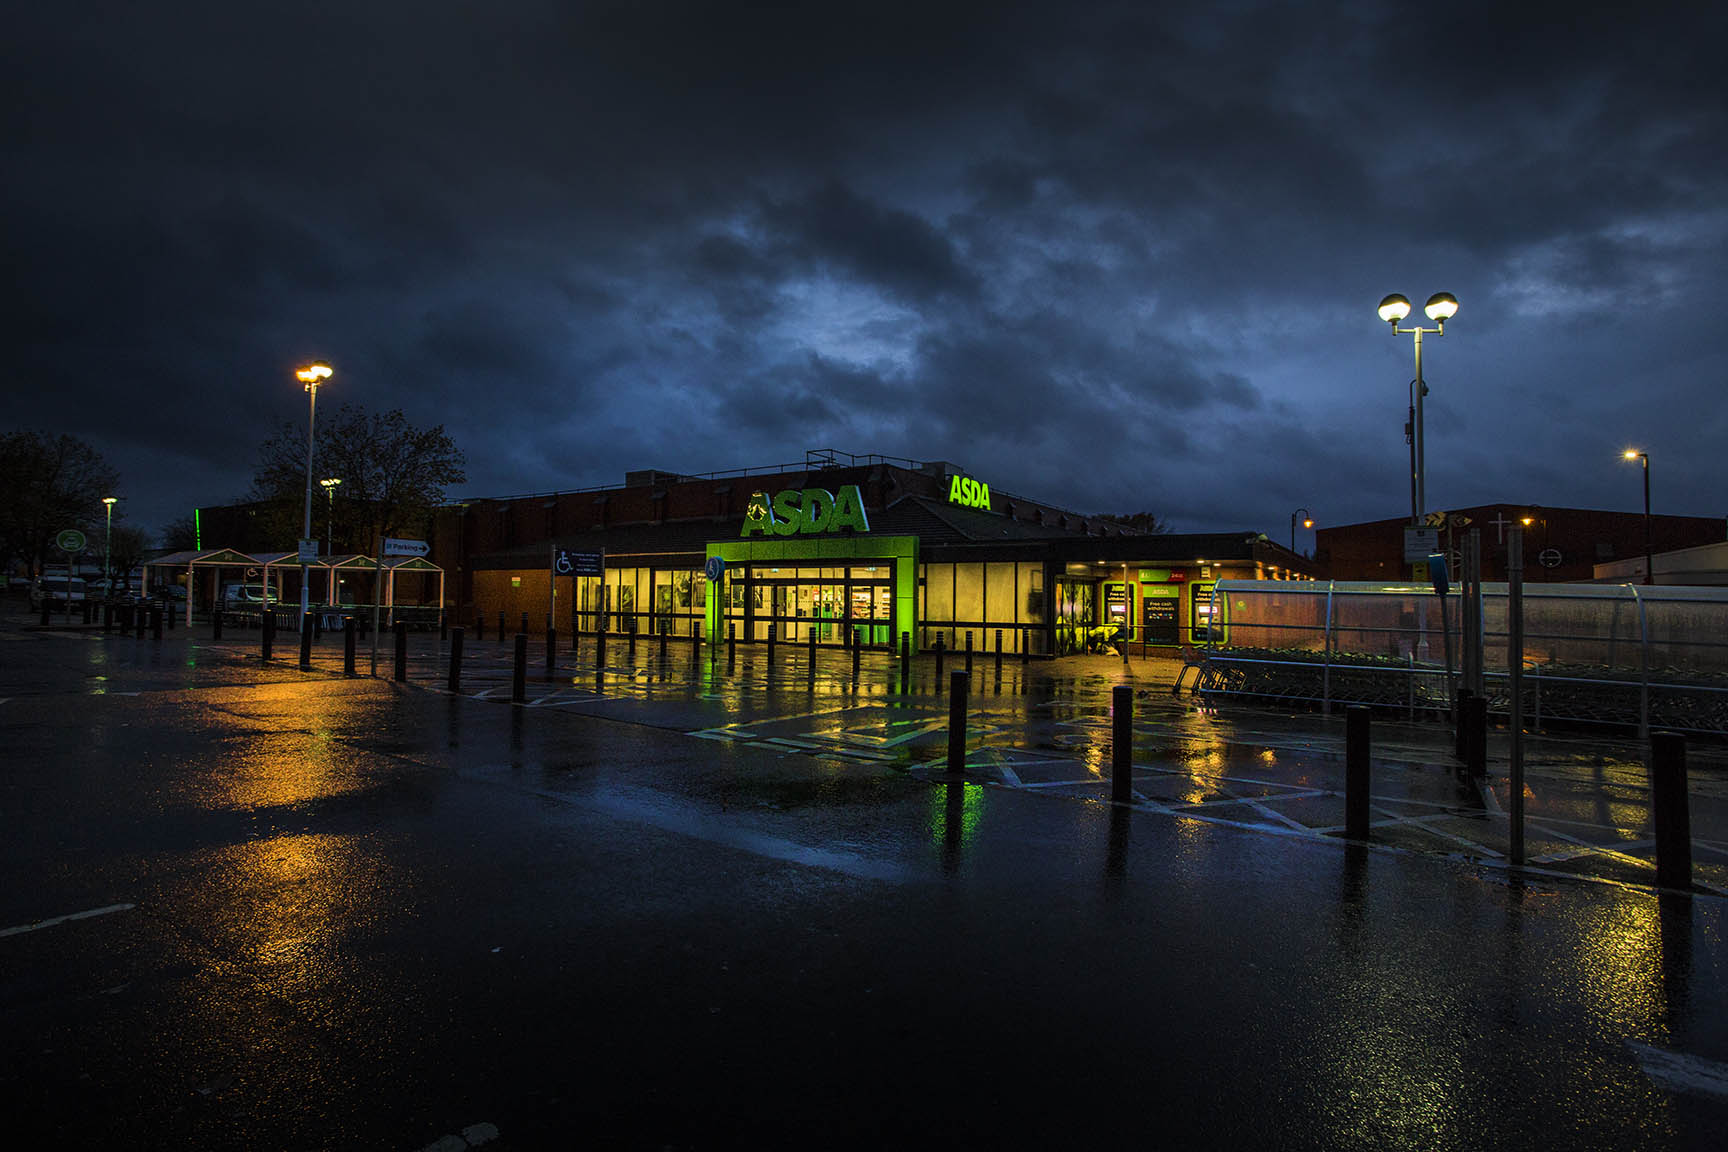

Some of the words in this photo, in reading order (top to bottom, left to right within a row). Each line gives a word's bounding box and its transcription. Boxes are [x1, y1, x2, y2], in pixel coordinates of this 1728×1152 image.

[949, 474, 992, 511] ASDA
[740, 485, 870, 538] ASDA
[393, 543, 418, 552] Parking
